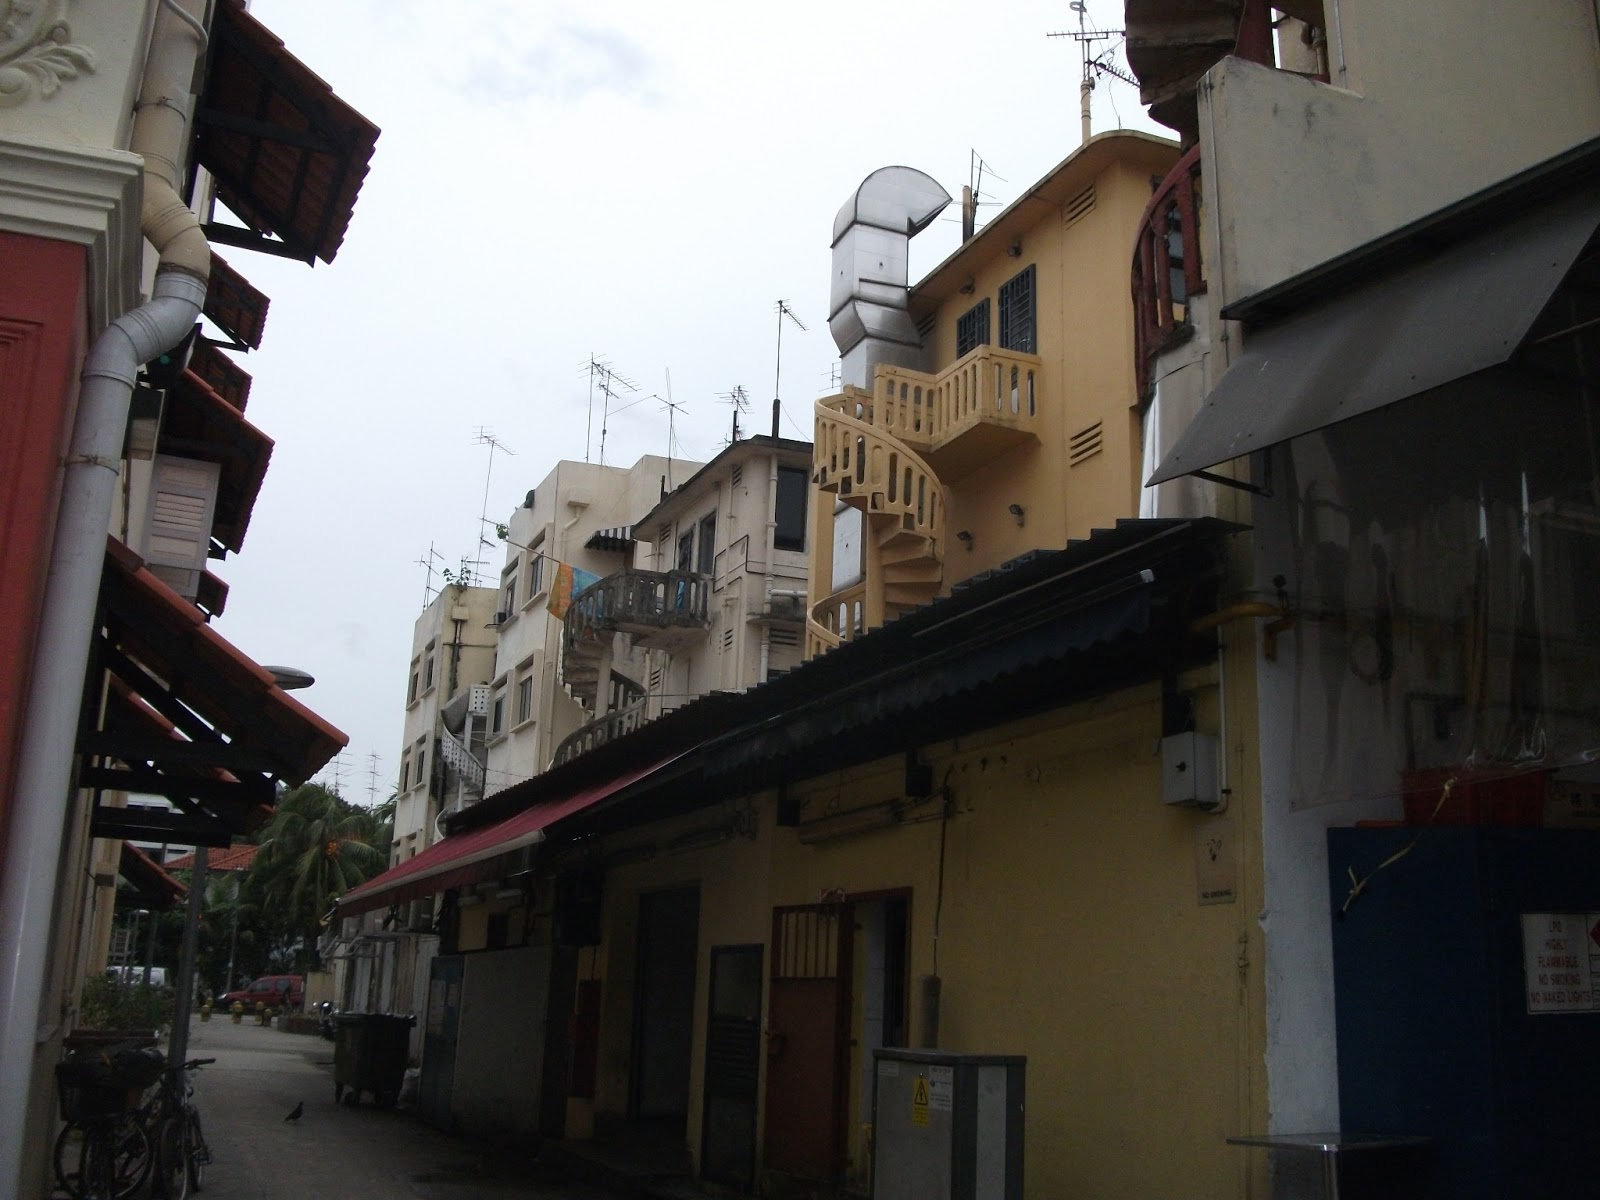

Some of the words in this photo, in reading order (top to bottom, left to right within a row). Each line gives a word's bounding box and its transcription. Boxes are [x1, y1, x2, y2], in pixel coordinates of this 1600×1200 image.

[1538, 956, 1578, 968] FLAMMABLE
[1538, 974, 1549, 986] NO
[1551, 973, 1581, 985] SMOKING
[1530, 992, 1540, 1004] NO
[1543, 991, 1565, 1003] NAKED
[1567, 990, 1591, 1003] LIGHTS
